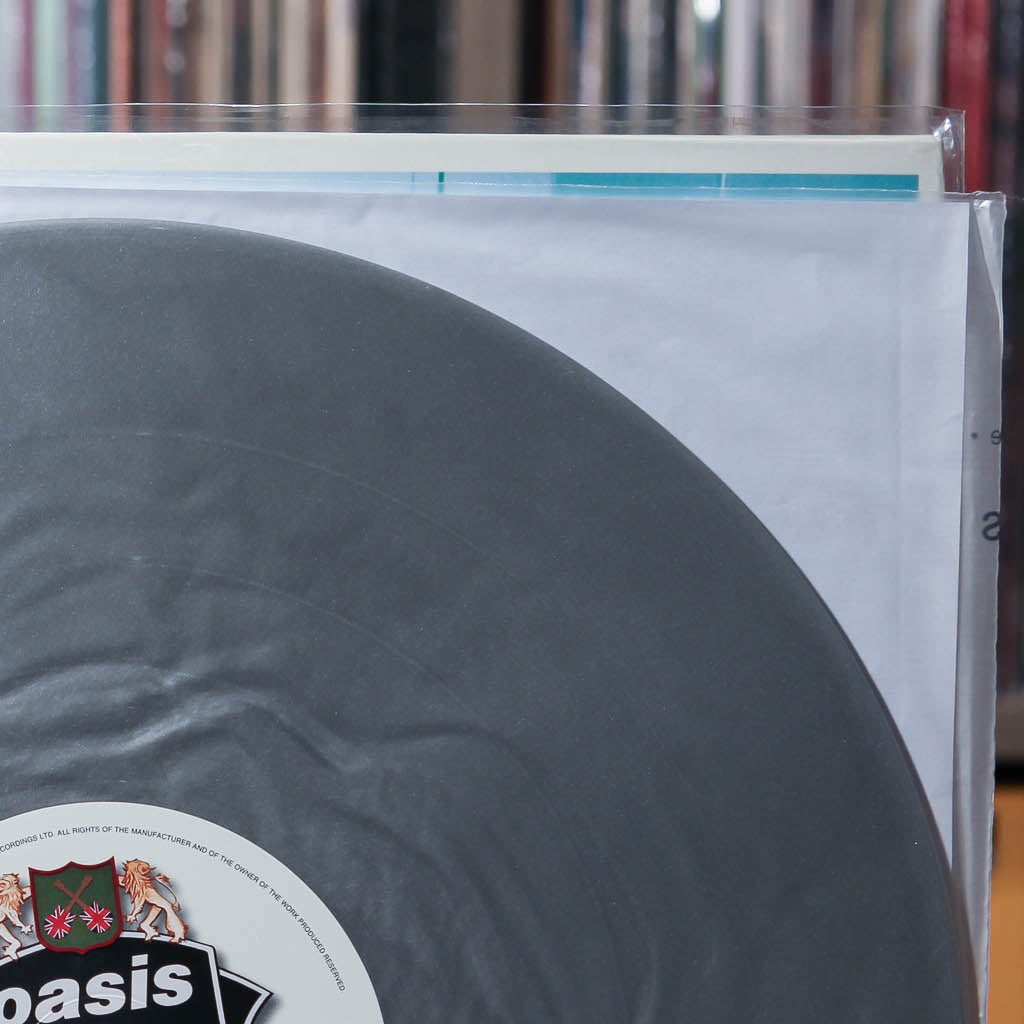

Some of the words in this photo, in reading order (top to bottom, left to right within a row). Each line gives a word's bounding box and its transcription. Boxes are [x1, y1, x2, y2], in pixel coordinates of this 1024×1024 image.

[72, 826, 100, 834] RIGHTS
[131, 828, 191, 847] MANUFACTURER
[192, 843, 207, 853] AND
[221, 855, 234, 867] THE
[232, 864, 259, 883] OWNER
[259, 881, 269, 889] OF
[269, 889, 282, 901] THE
[281, 900, 299, 919] WORK
[297, 918, 325, 953] PRODUCED
[323, 954, 345, 991] RESERVED
